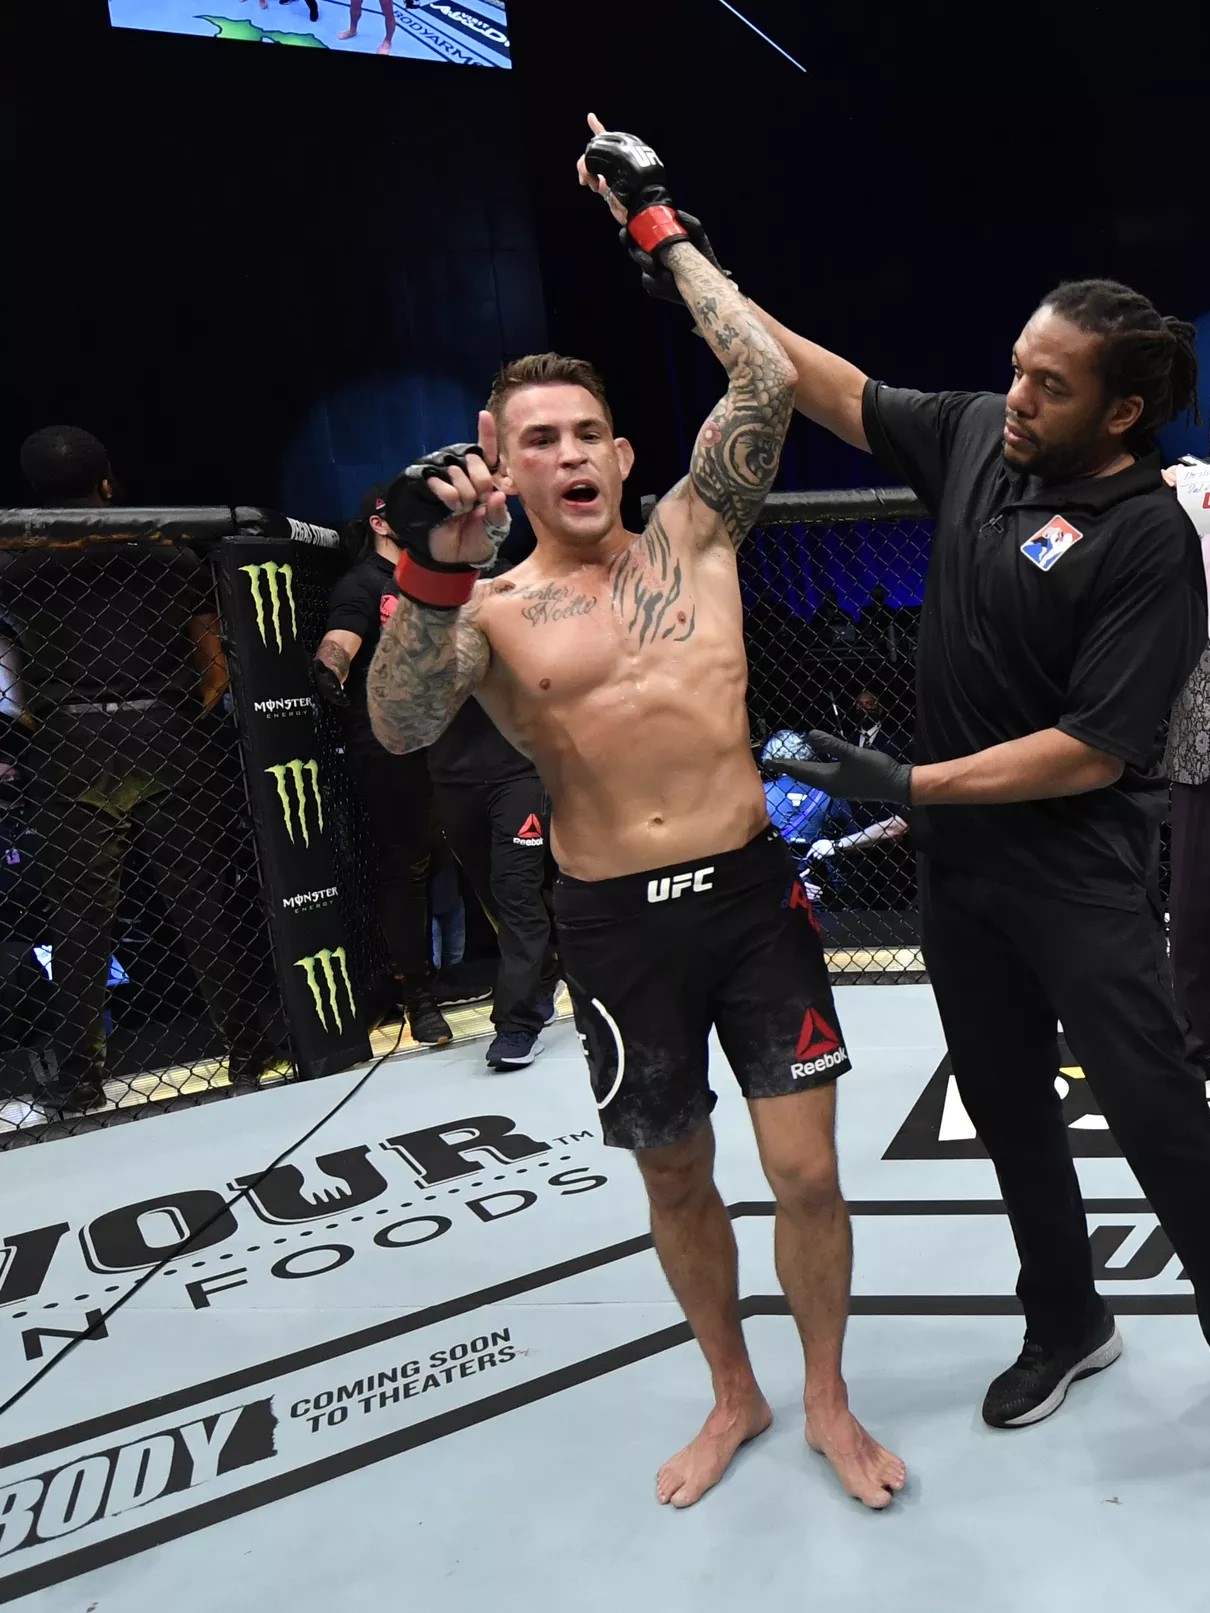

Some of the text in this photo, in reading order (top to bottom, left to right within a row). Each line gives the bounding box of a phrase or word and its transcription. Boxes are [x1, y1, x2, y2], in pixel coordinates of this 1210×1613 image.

[254, 698, 312, 713] MONSTER
[283, 886, 339, 908] MONSTER
[648, 867, 715, 903] UFC
[791, 1047, 848, 1080] Reebok
[185, 1166, 608, 1310] FOODS
[290, 1327, 511, 1419] COMING SOON
[306, 1345, 517, 1433] TO THEATERS
